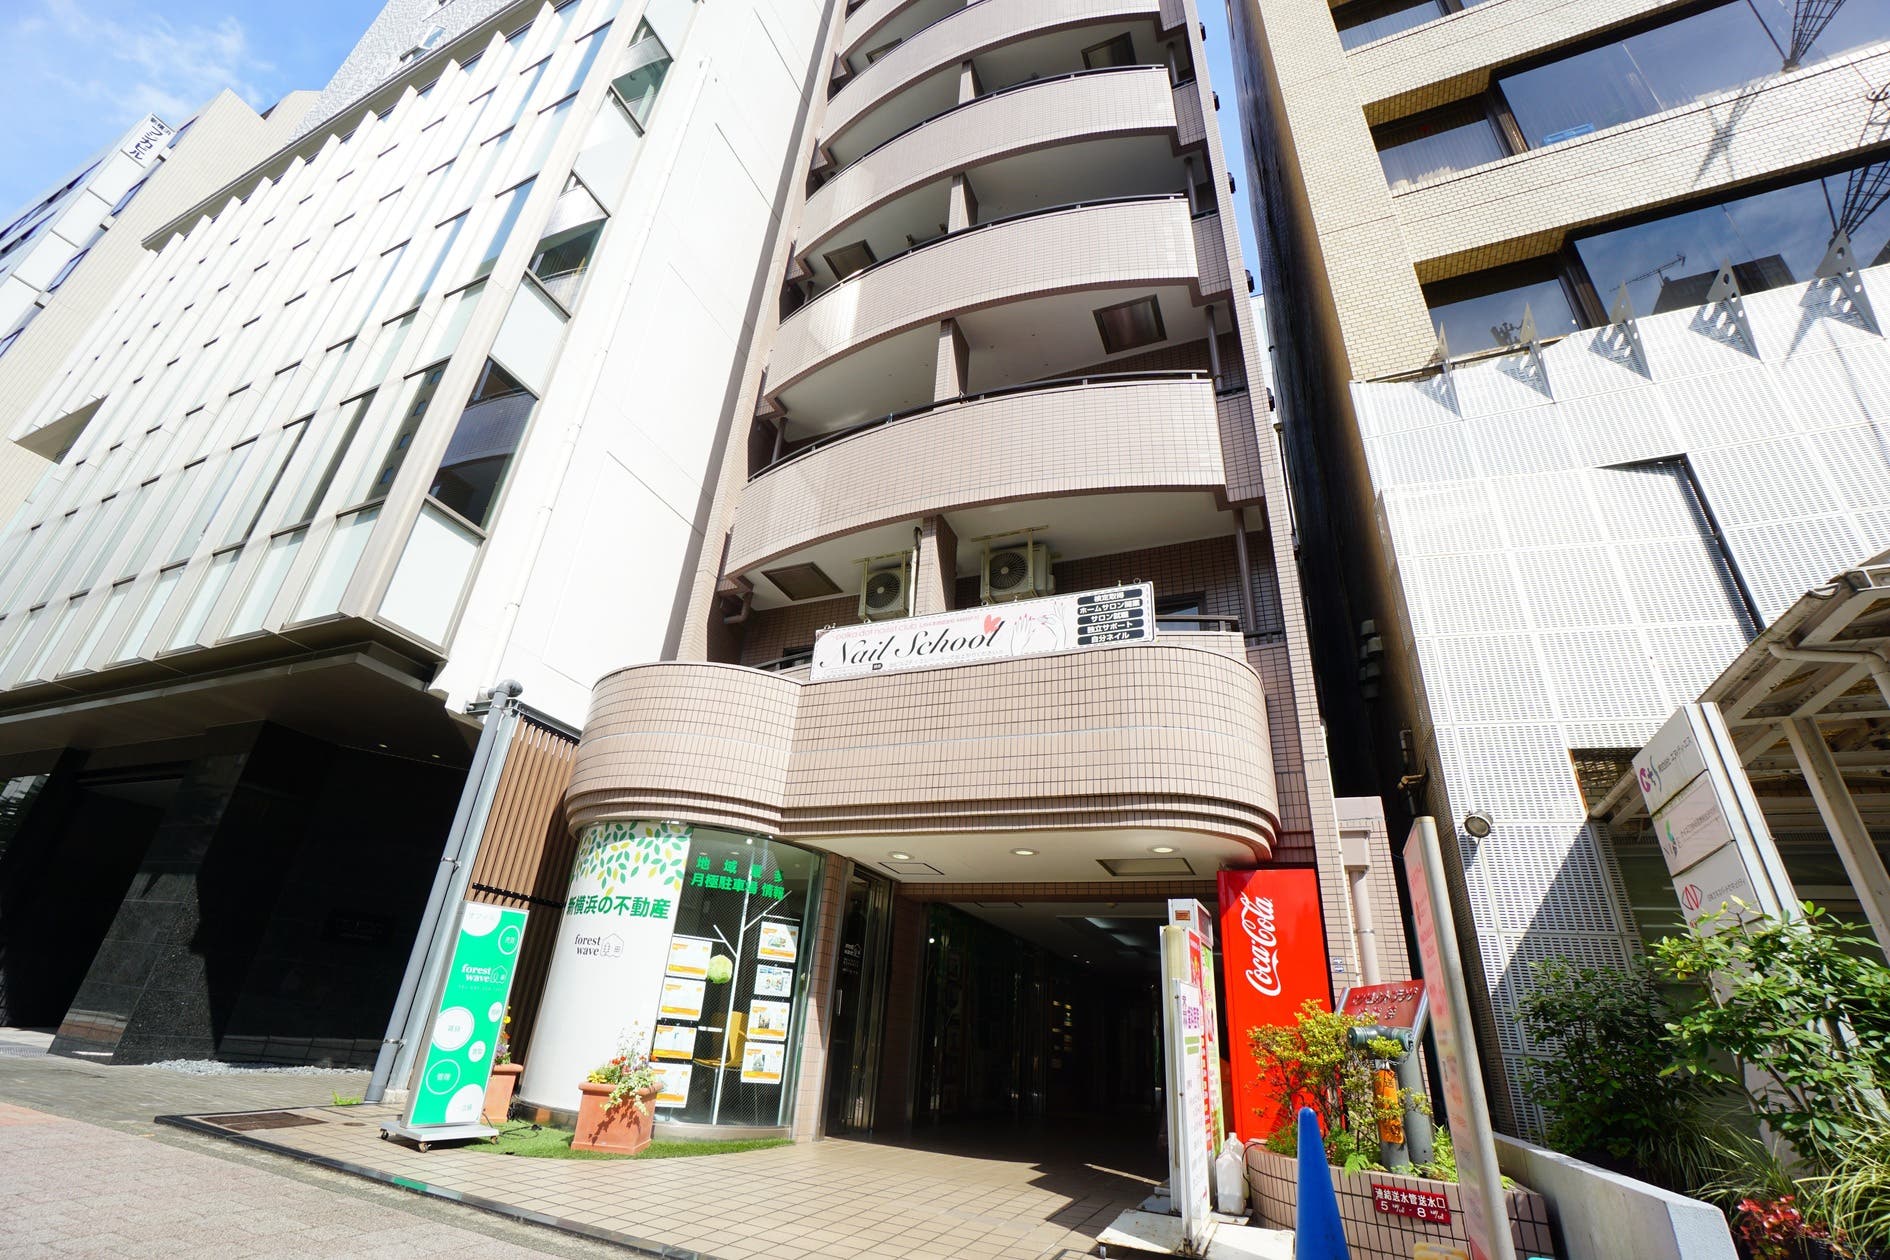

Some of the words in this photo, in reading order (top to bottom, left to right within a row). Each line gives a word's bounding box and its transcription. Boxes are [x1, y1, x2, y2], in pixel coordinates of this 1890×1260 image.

[819, 634, 896, 668] Nail
[894, 620, 1006, 659] School
[1091, 632, 1130, 644] 自分ネイル
[566, 894, 672, 919] 新横浜の不動産
[574, 934, 601, 946] forest
[1240, 890, 1282, 996] Coca-Cola
[576, 947, 600, 956] wave
[461, 963, 492, 974] forest
[465, 974, 491, 983] wave
[1374, 1187, 1446, 1209] 連結送水管送水口
[1380, 1200, 1389, 1211] 5
[1417, 1208, 1427, 1218] 8
